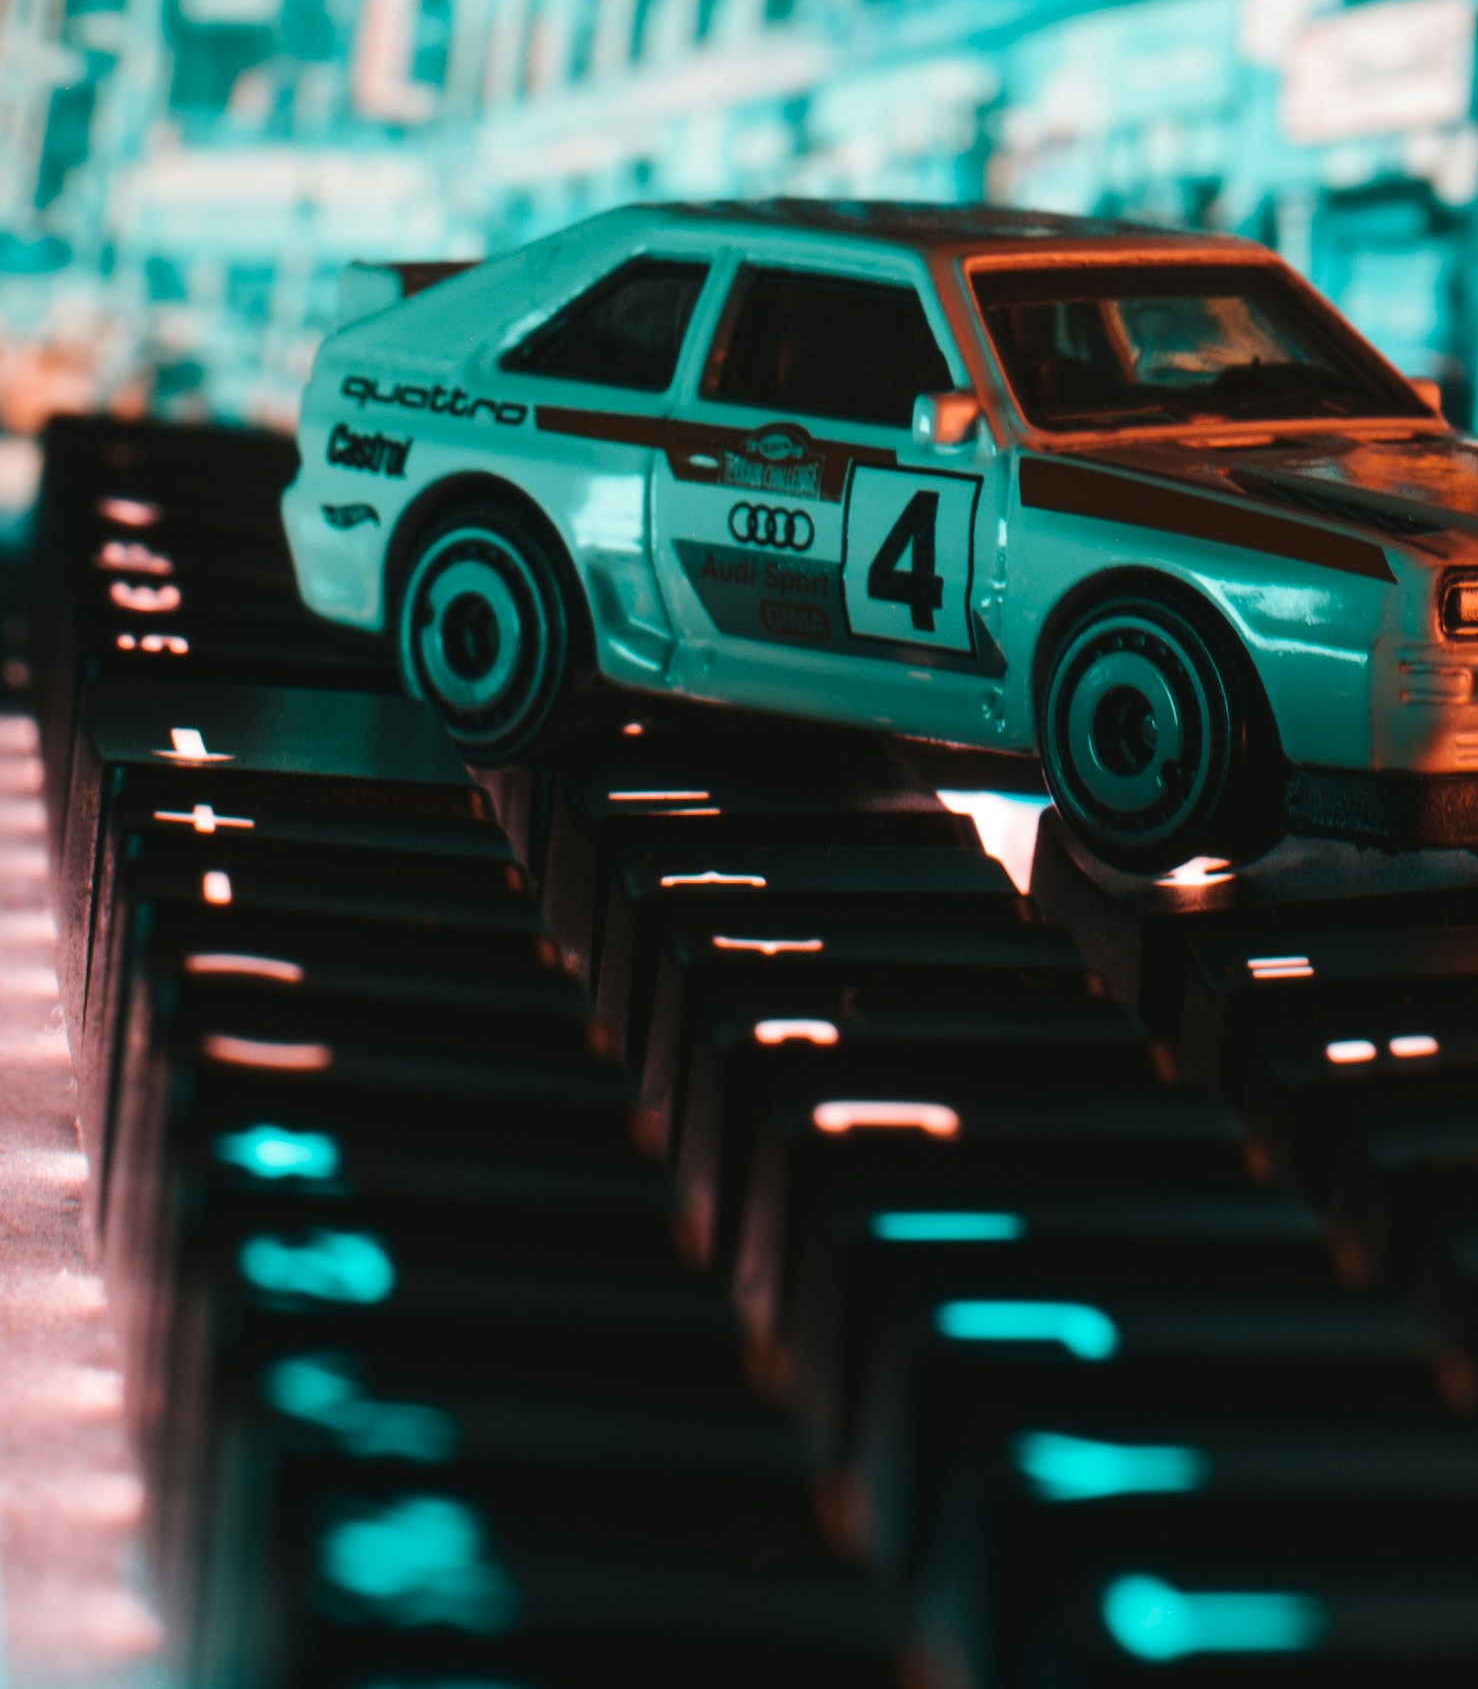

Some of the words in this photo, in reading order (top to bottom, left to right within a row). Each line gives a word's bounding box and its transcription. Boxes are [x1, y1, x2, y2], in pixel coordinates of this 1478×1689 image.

[342, 375, 527, 426] quattro
[327, 422, 414, 479] Castrol
[699, 553, 757, 588] Audi
[763, 560, 831, 599] Sport
[867, 489, 944, 633] 4
